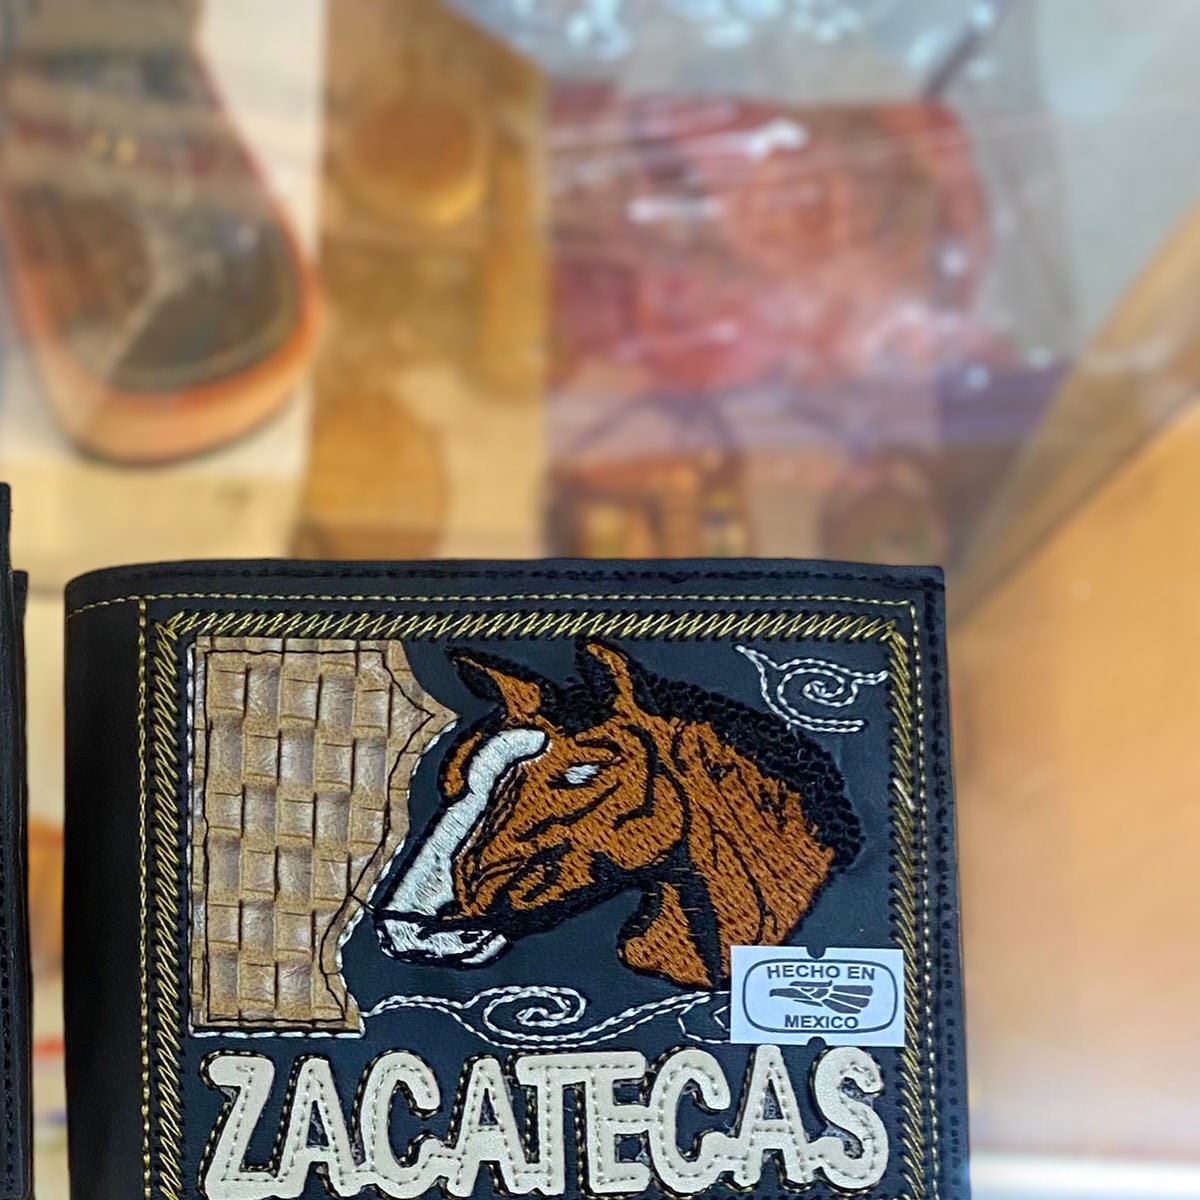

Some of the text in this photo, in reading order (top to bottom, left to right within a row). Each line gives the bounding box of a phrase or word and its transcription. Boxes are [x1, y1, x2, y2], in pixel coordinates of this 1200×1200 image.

[767, 965, 875, 981] HECHO EN
[784, 1014, 859, 1029] MEXICO
